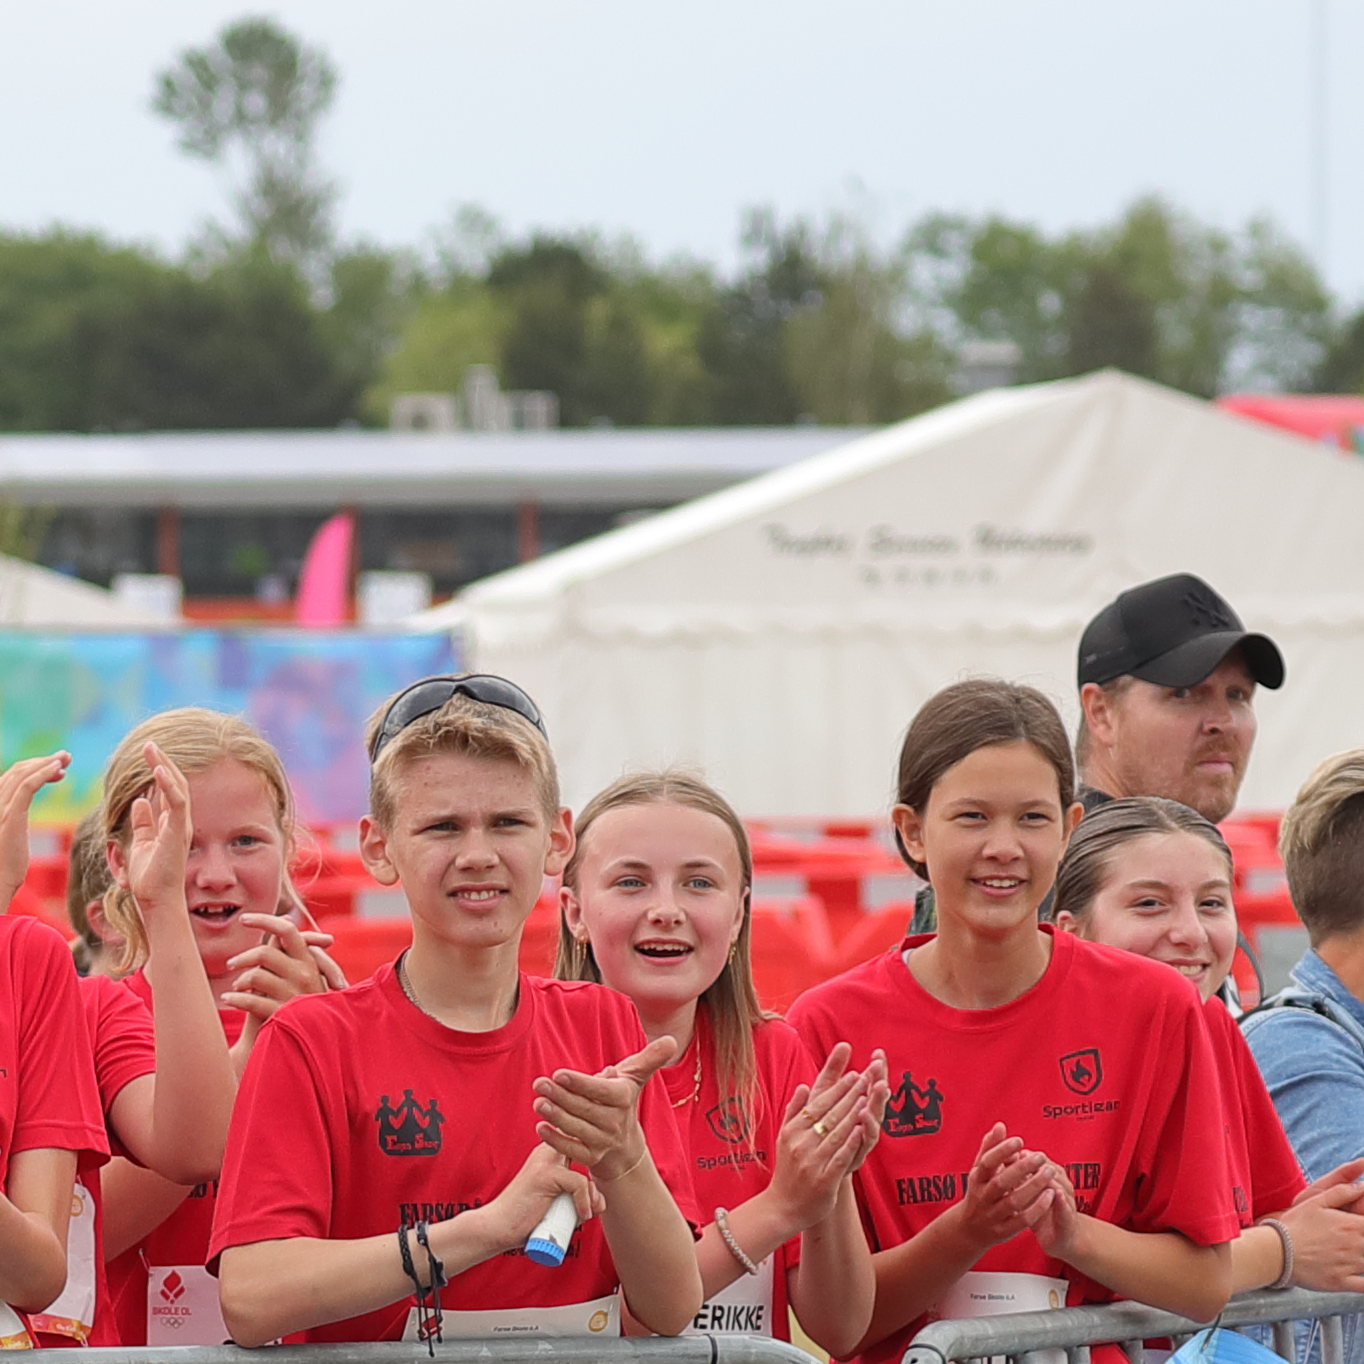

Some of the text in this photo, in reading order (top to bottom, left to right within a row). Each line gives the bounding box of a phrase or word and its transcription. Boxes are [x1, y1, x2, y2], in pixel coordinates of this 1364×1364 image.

[896, 1174, 956, 1206] FARSØ
[152, 1306, 180, 1316] SKOLE
[694, 1304, 764, 1331] ERIKKE
